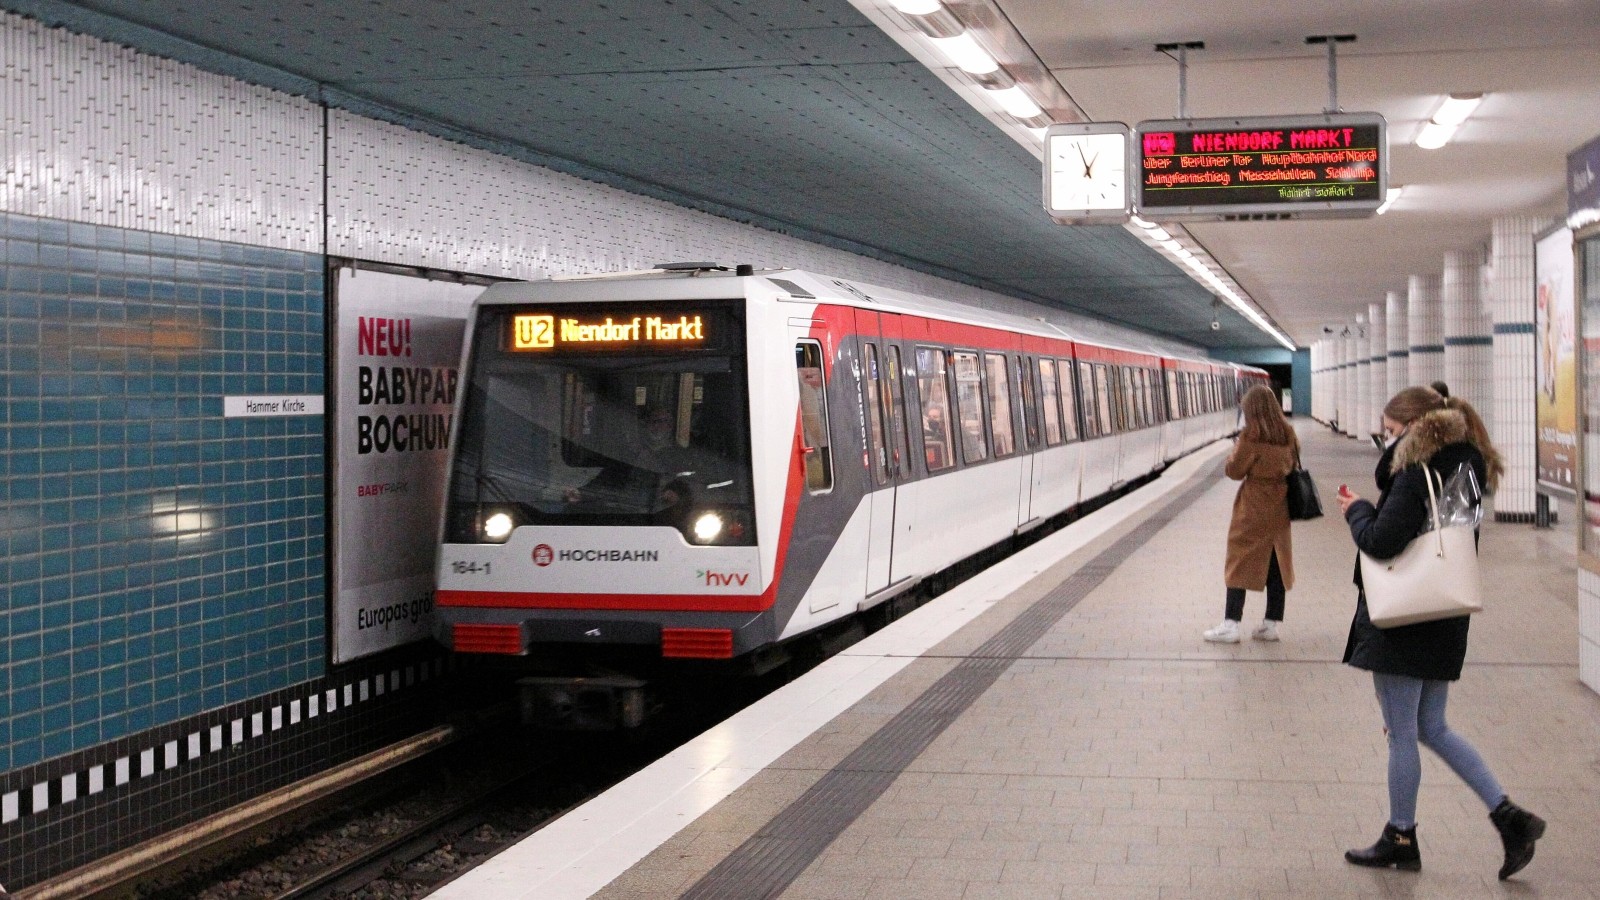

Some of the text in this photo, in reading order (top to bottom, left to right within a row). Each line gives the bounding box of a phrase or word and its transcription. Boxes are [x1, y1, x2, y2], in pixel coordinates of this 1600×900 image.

[1192, 131, 1284, 152] NIENDORF
[1290, 127, 1354, 149] MARKT
[1181, 155, 1231, 168] Berliner
[1232, 154, 1253, 167] Tor
[1145, 170, 1231, 187] Jungfernstieg
[358, 316, 412, 357] NEU!
[518, 316, 704, 345] U2 Niendorf Markt
[246, 399, 305, 413] Hammer Kirche
[358, 414, 453, 455] BOCHUM
[358, 482, 408, 497] BABYPARK
[559, 549, 659, 563] HOCHBAHN
[451, 560, 492, 575] 164-1
[705, 570, 749, 586] hvv
[358, 592, 433, 631] Europas grö
